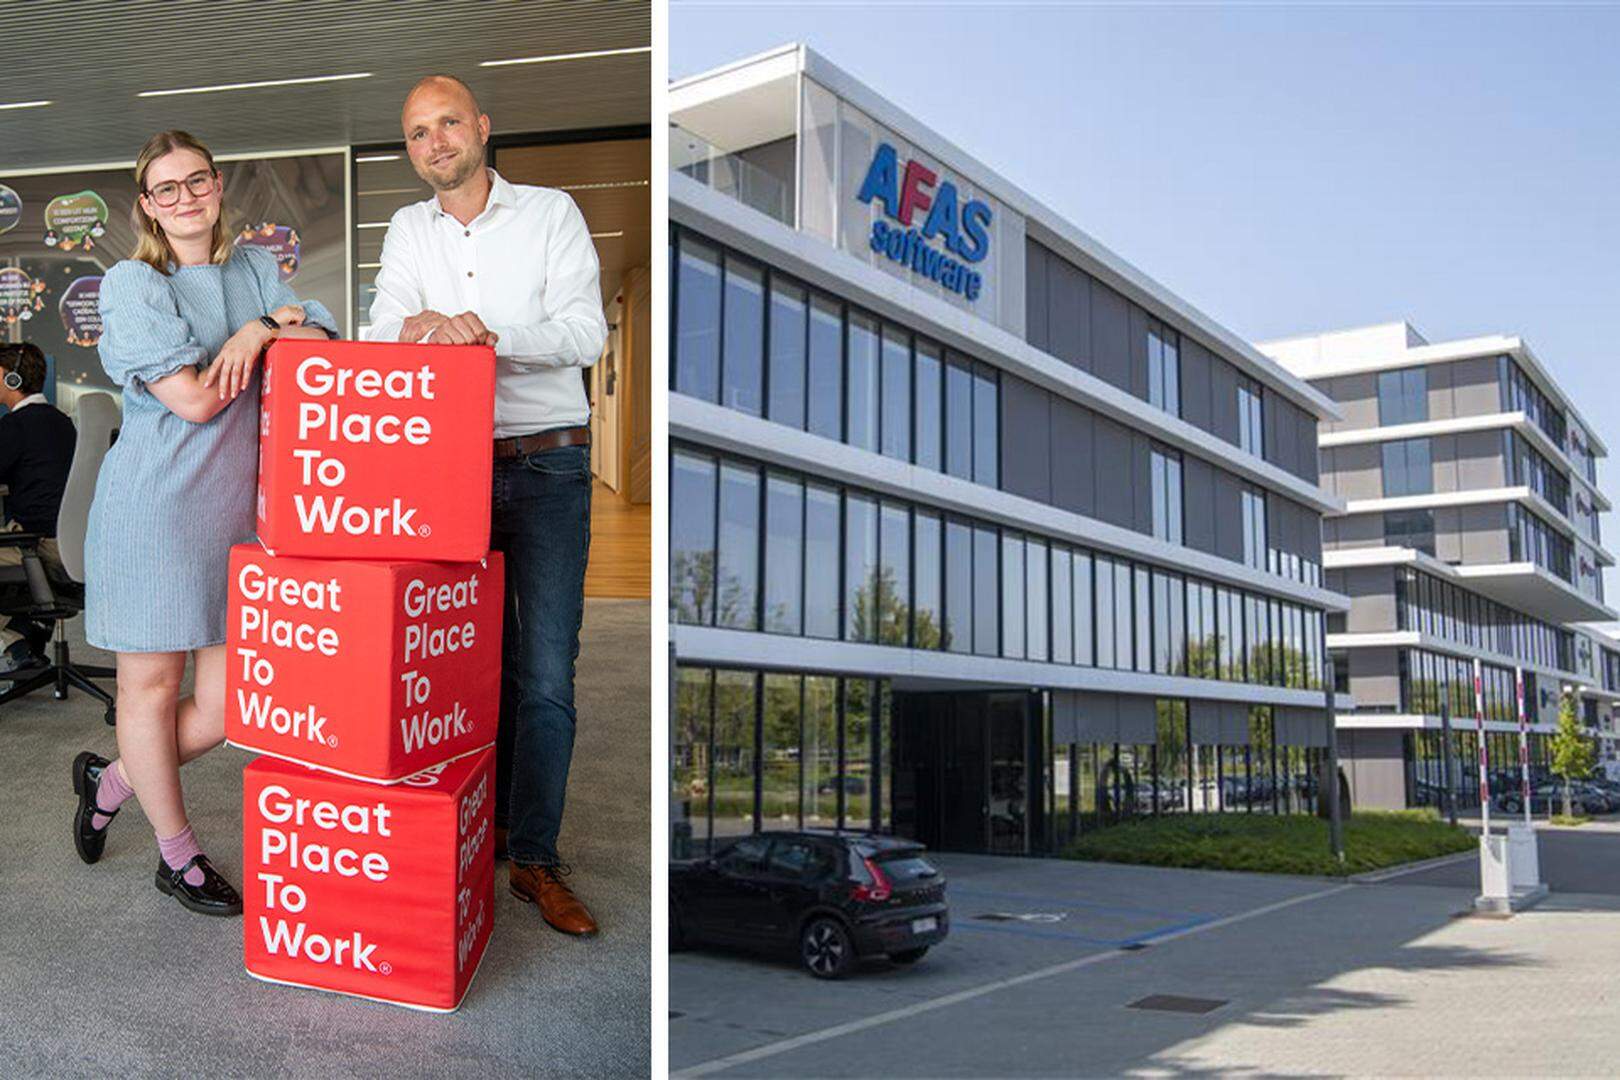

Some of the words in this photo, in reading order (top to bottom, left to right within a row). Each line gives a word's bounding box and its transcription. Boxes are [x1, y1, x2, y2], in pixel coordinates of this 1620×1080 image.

[856, 142, 992, 264] AFAS
[870, 220, 982, 302] software
[296, 356, 435, 400] Great
[298, 402, 431, 445] Place
[293, 449, 346, 487] To
[238, 564, 342, 612] Great
[404, 574, 479, 618] Great
[240, 606, 340, 656] Place
[404, 621, 476, 663] Place
[237, 648, 274, 686] To
[401, 670, 431, 708] To
[258, 785, 391, 837] Great
[460, 773, 488, 836] Great
[261, 827, 390, 882] Place
[458, 818, 488, 884] Place
[257, 873, 307, 913] To
